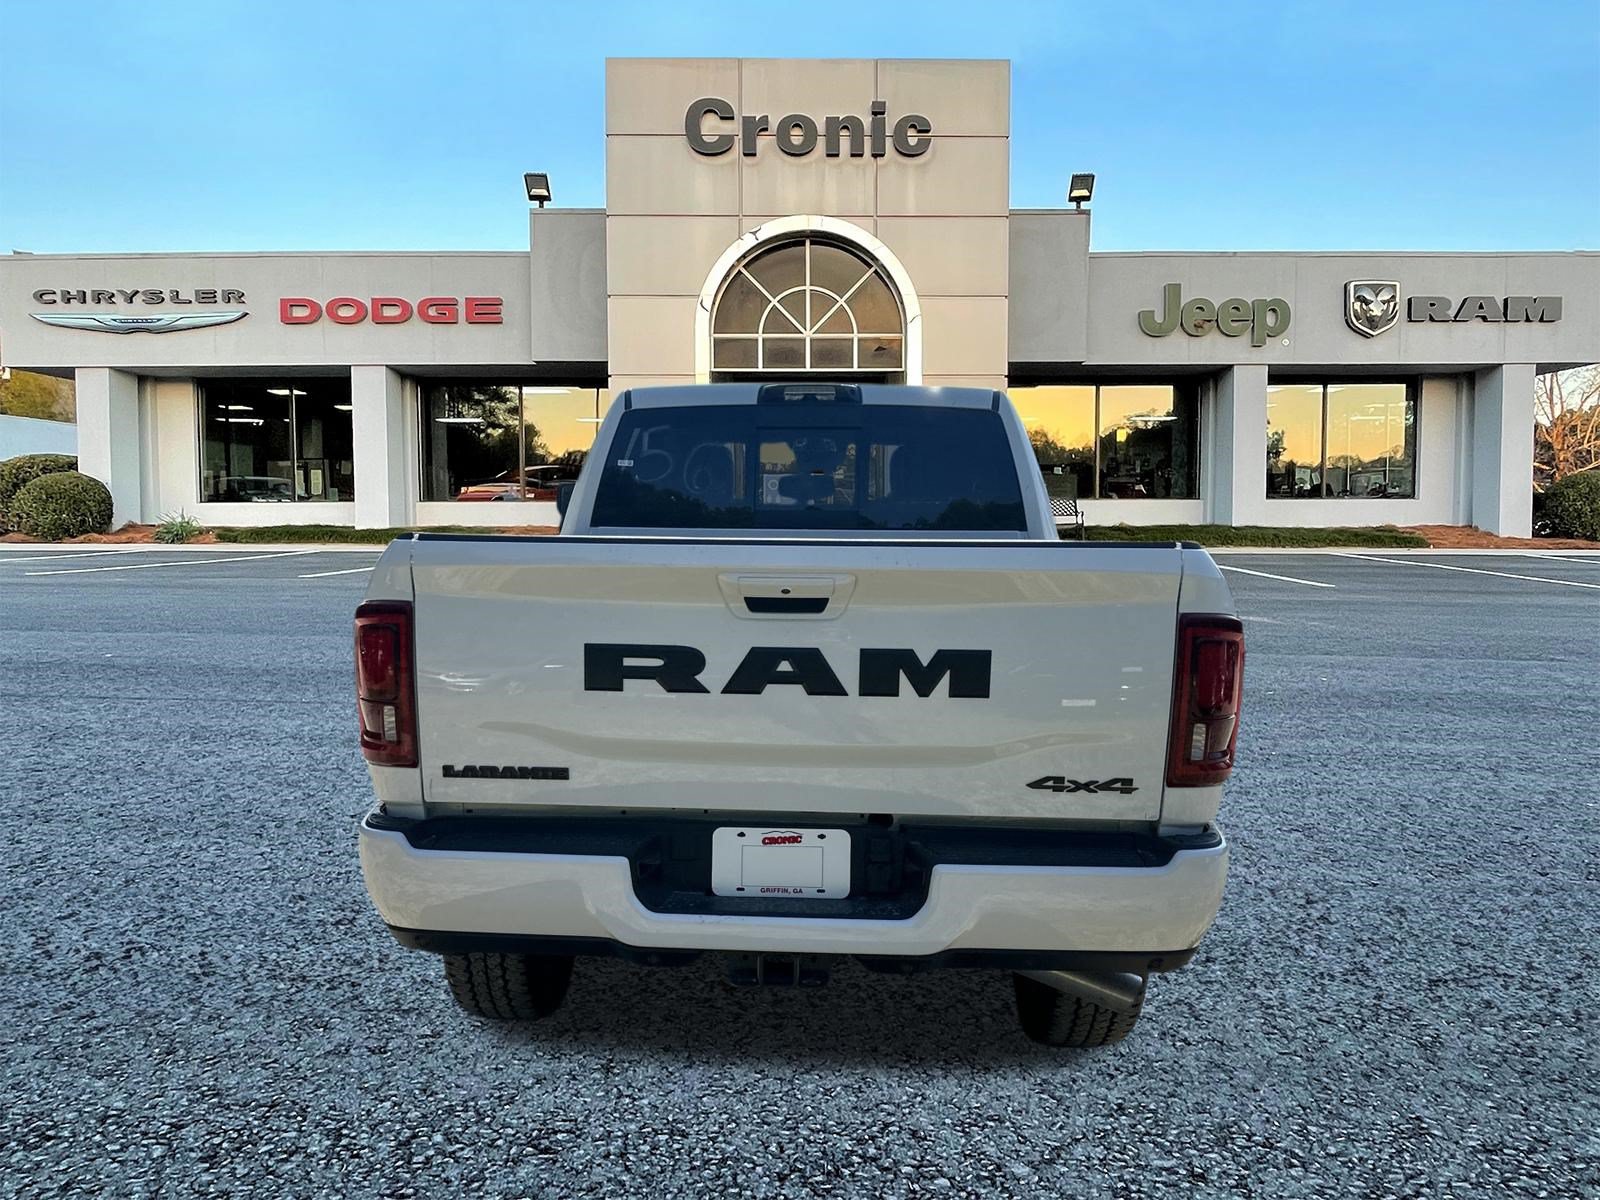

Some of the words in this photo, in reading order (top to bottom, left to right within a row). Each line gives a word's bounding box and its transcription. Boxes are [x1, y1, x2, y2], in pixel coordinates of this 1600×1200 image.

[685, 97, 932, 157] Cronic
[32, 289, 247, 305] CHRYSLER
[1407, 296, 1562, 322] RAM
[280, 297, 503, 324] DODGE
[1138, 283, 1291, 347] Jeep
[584, 642, 993, 699] RAM
[1025, 775, 1140, 795] 4x4
[762, 836, 802, 845] CRONIC
